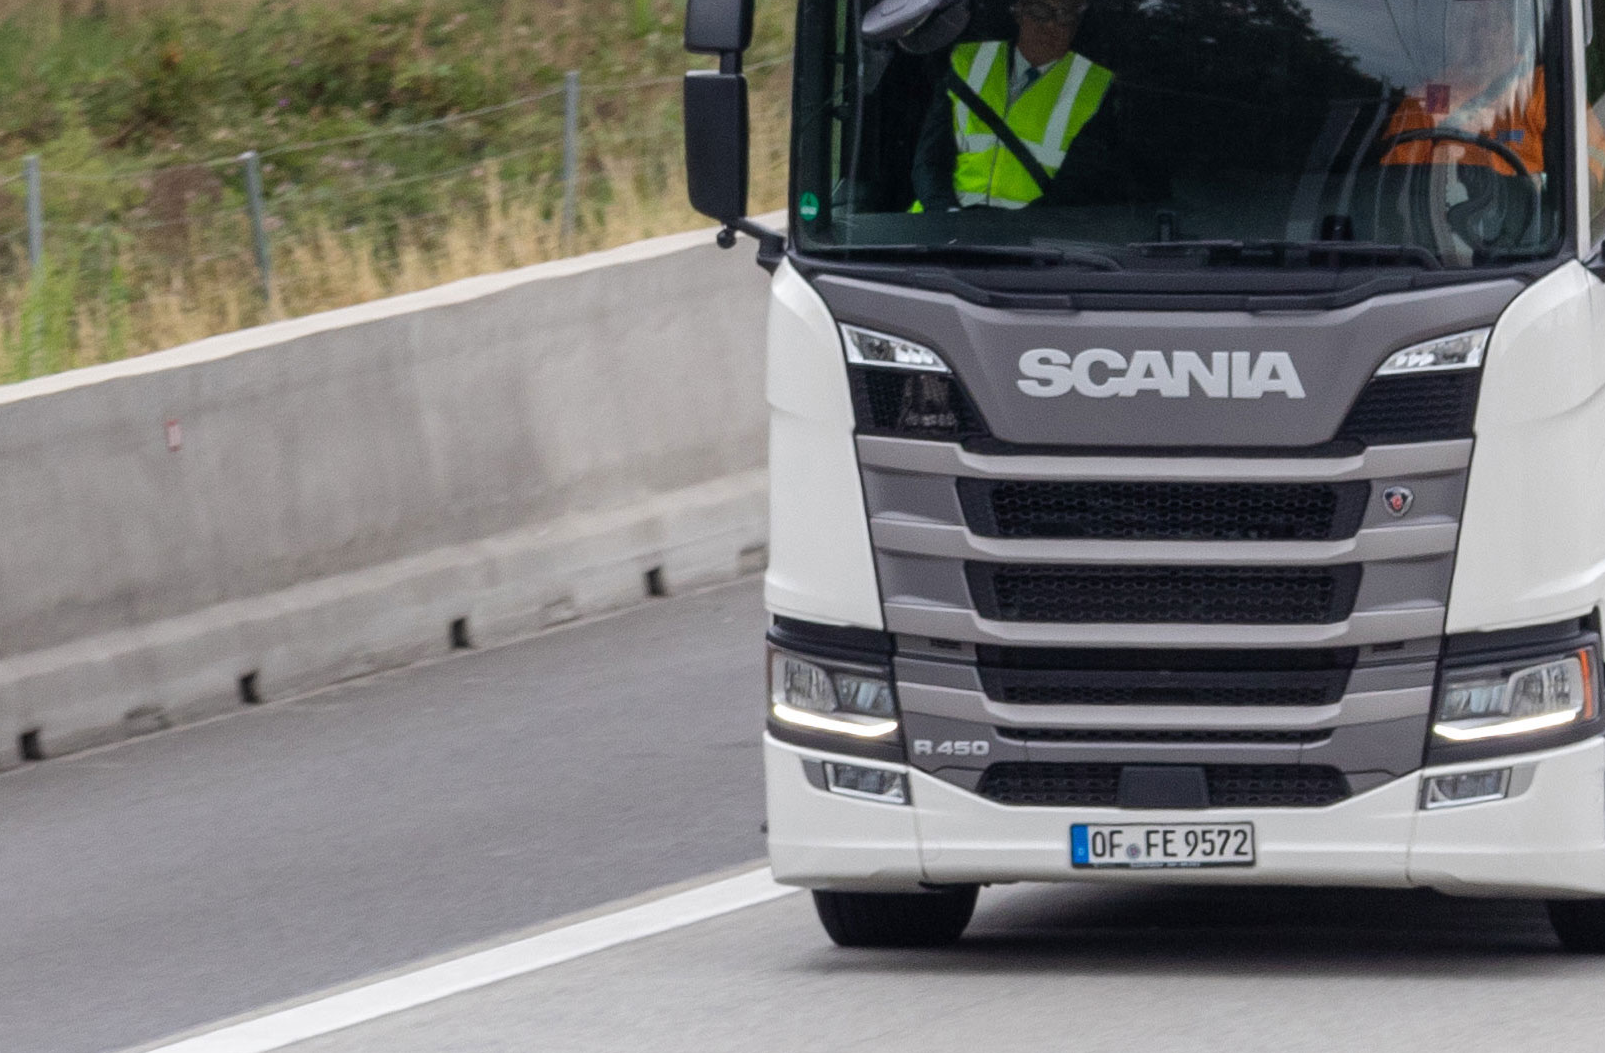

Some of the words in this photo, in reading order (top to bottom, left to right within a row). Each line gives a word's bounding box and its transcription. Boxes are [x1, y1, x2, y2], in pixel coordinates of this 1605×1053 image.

[1017, 348, 1306, 398] SCANIA
[913, 739, 933, 755] R
[936, 740, 990, 756] 450
[1092, 831, 1123, 858] OF
[1145, 829, 1176, 858] FE
[1184, 829, 1249, 857] 9572
